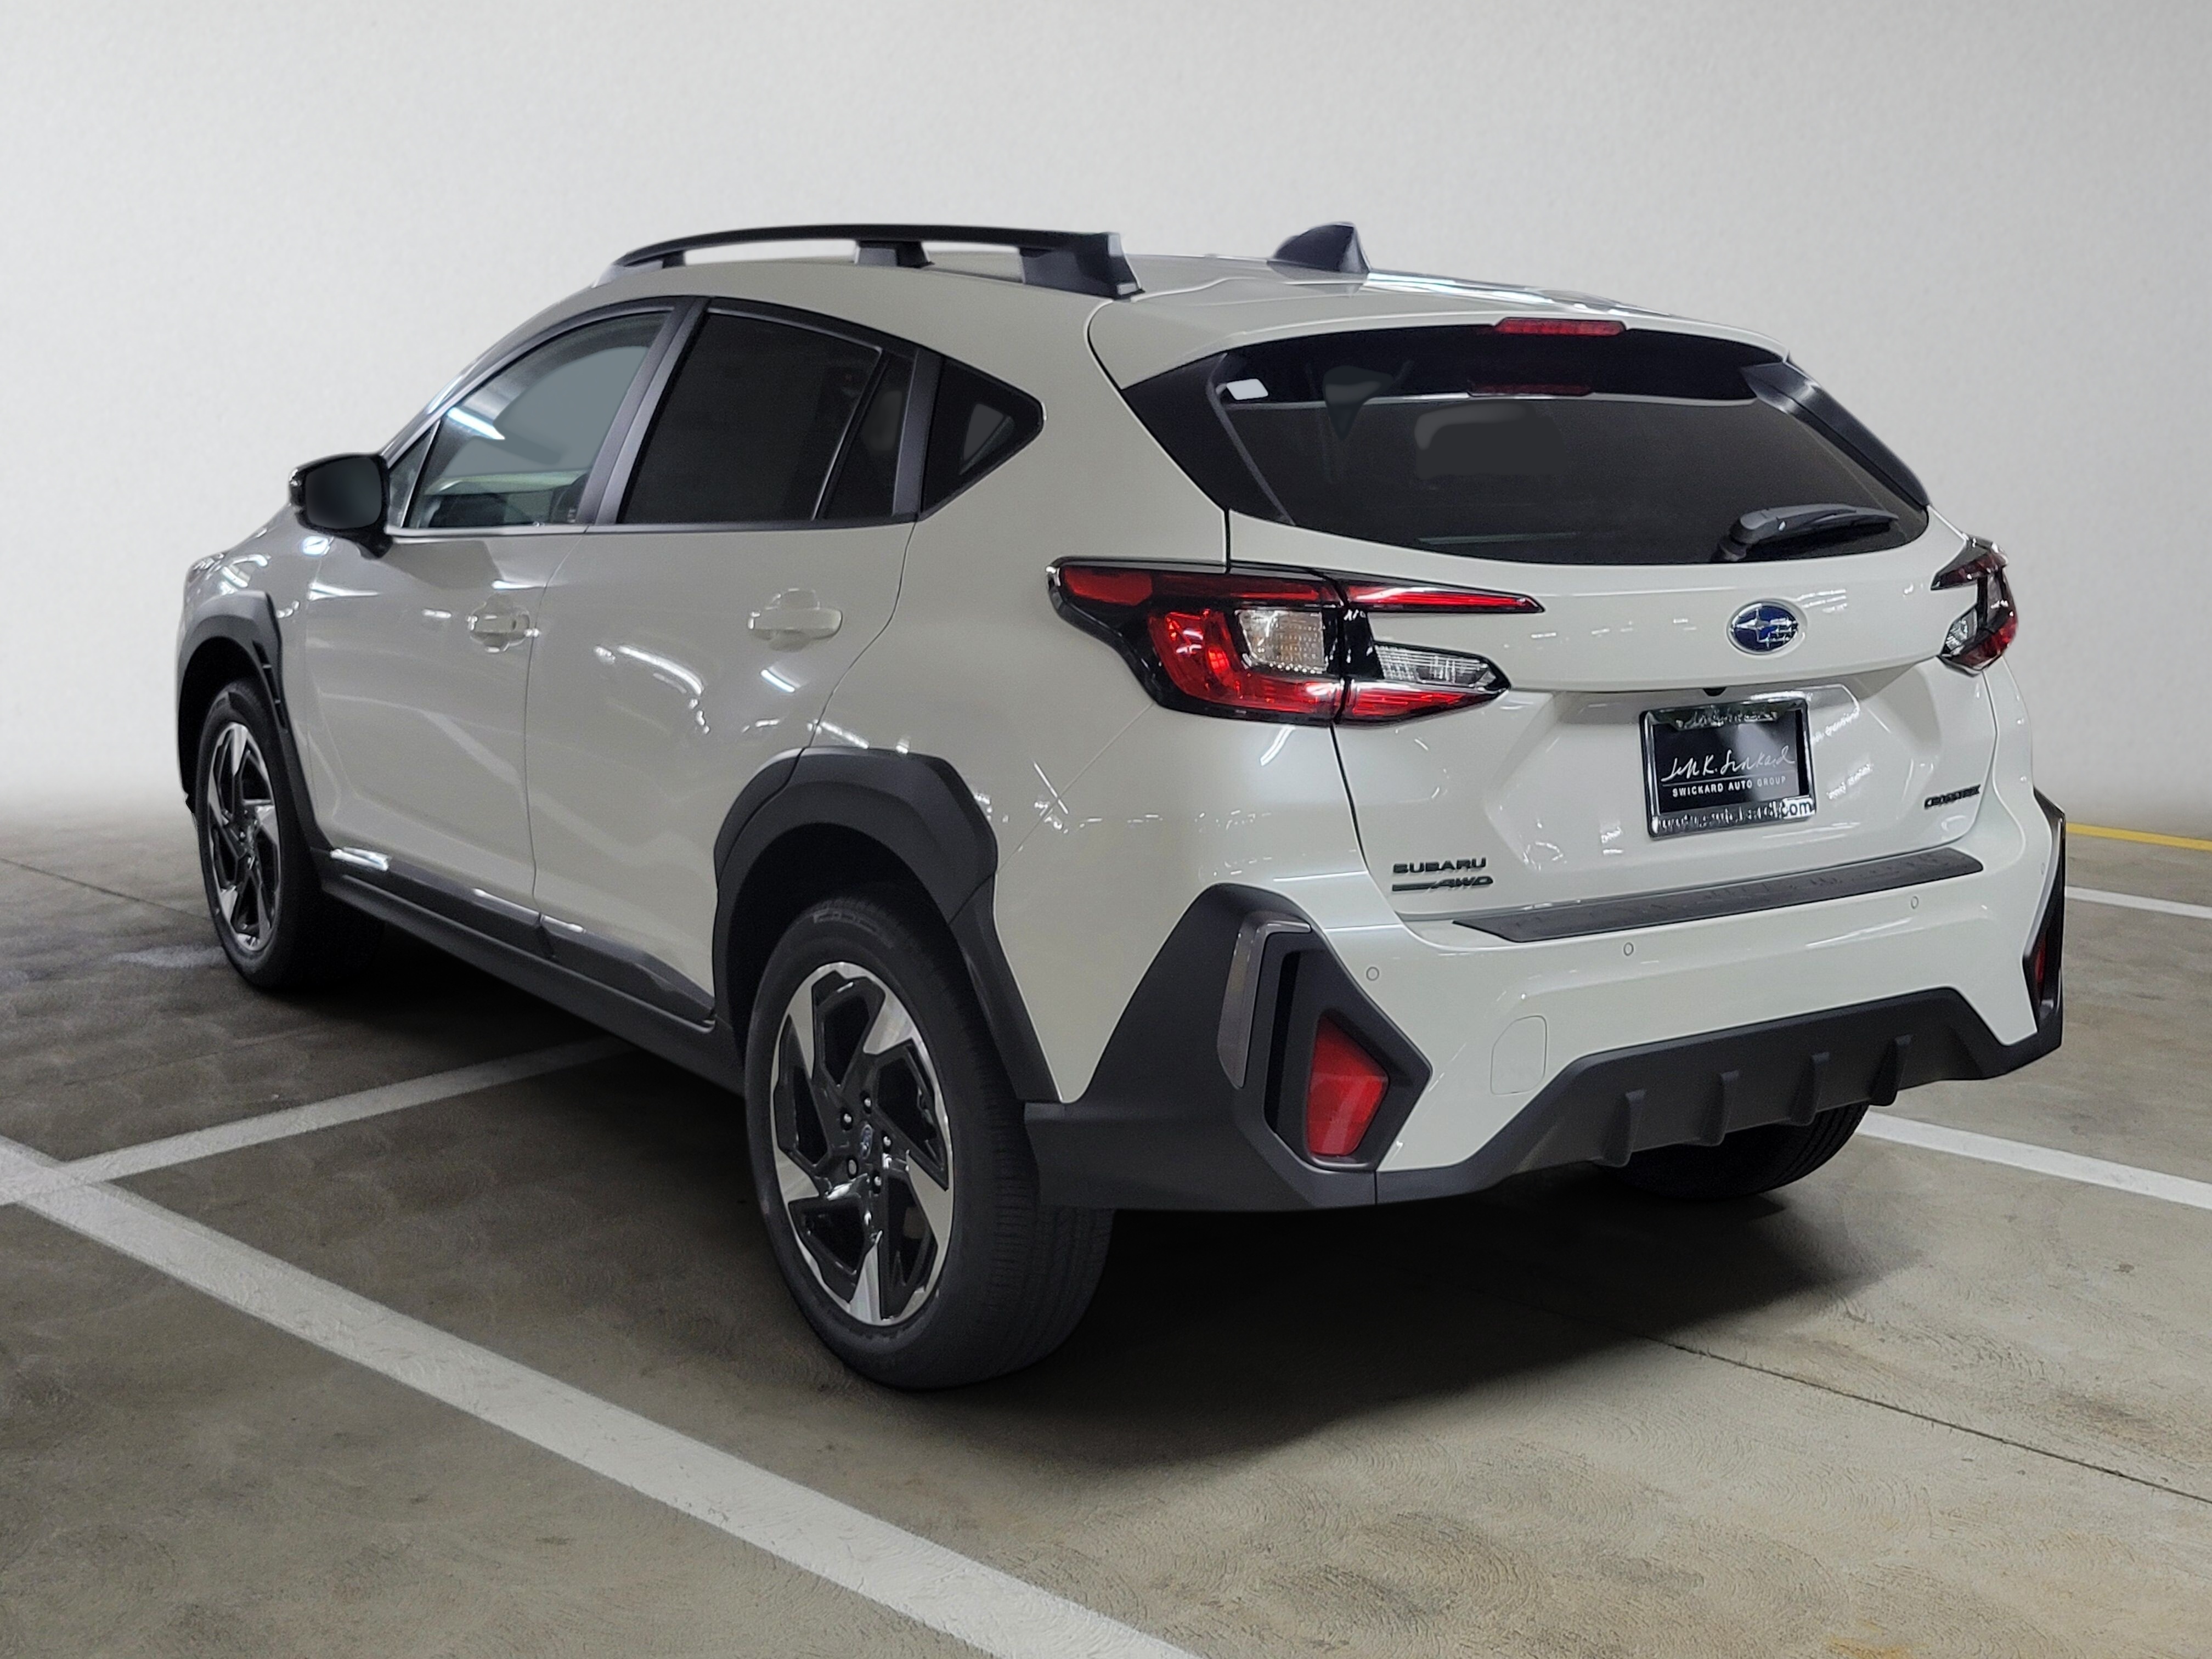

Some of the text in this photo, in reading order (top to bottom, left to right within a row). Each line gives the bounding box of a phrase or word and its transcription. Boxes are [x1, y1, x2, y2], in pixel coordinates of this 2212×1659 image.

[1672, 776, 1786, 797] SWICKARD AUTO GROUP
[1393, 857, 1486, 873] SUBARU
[1432, 876, 1493, 888] AWD
